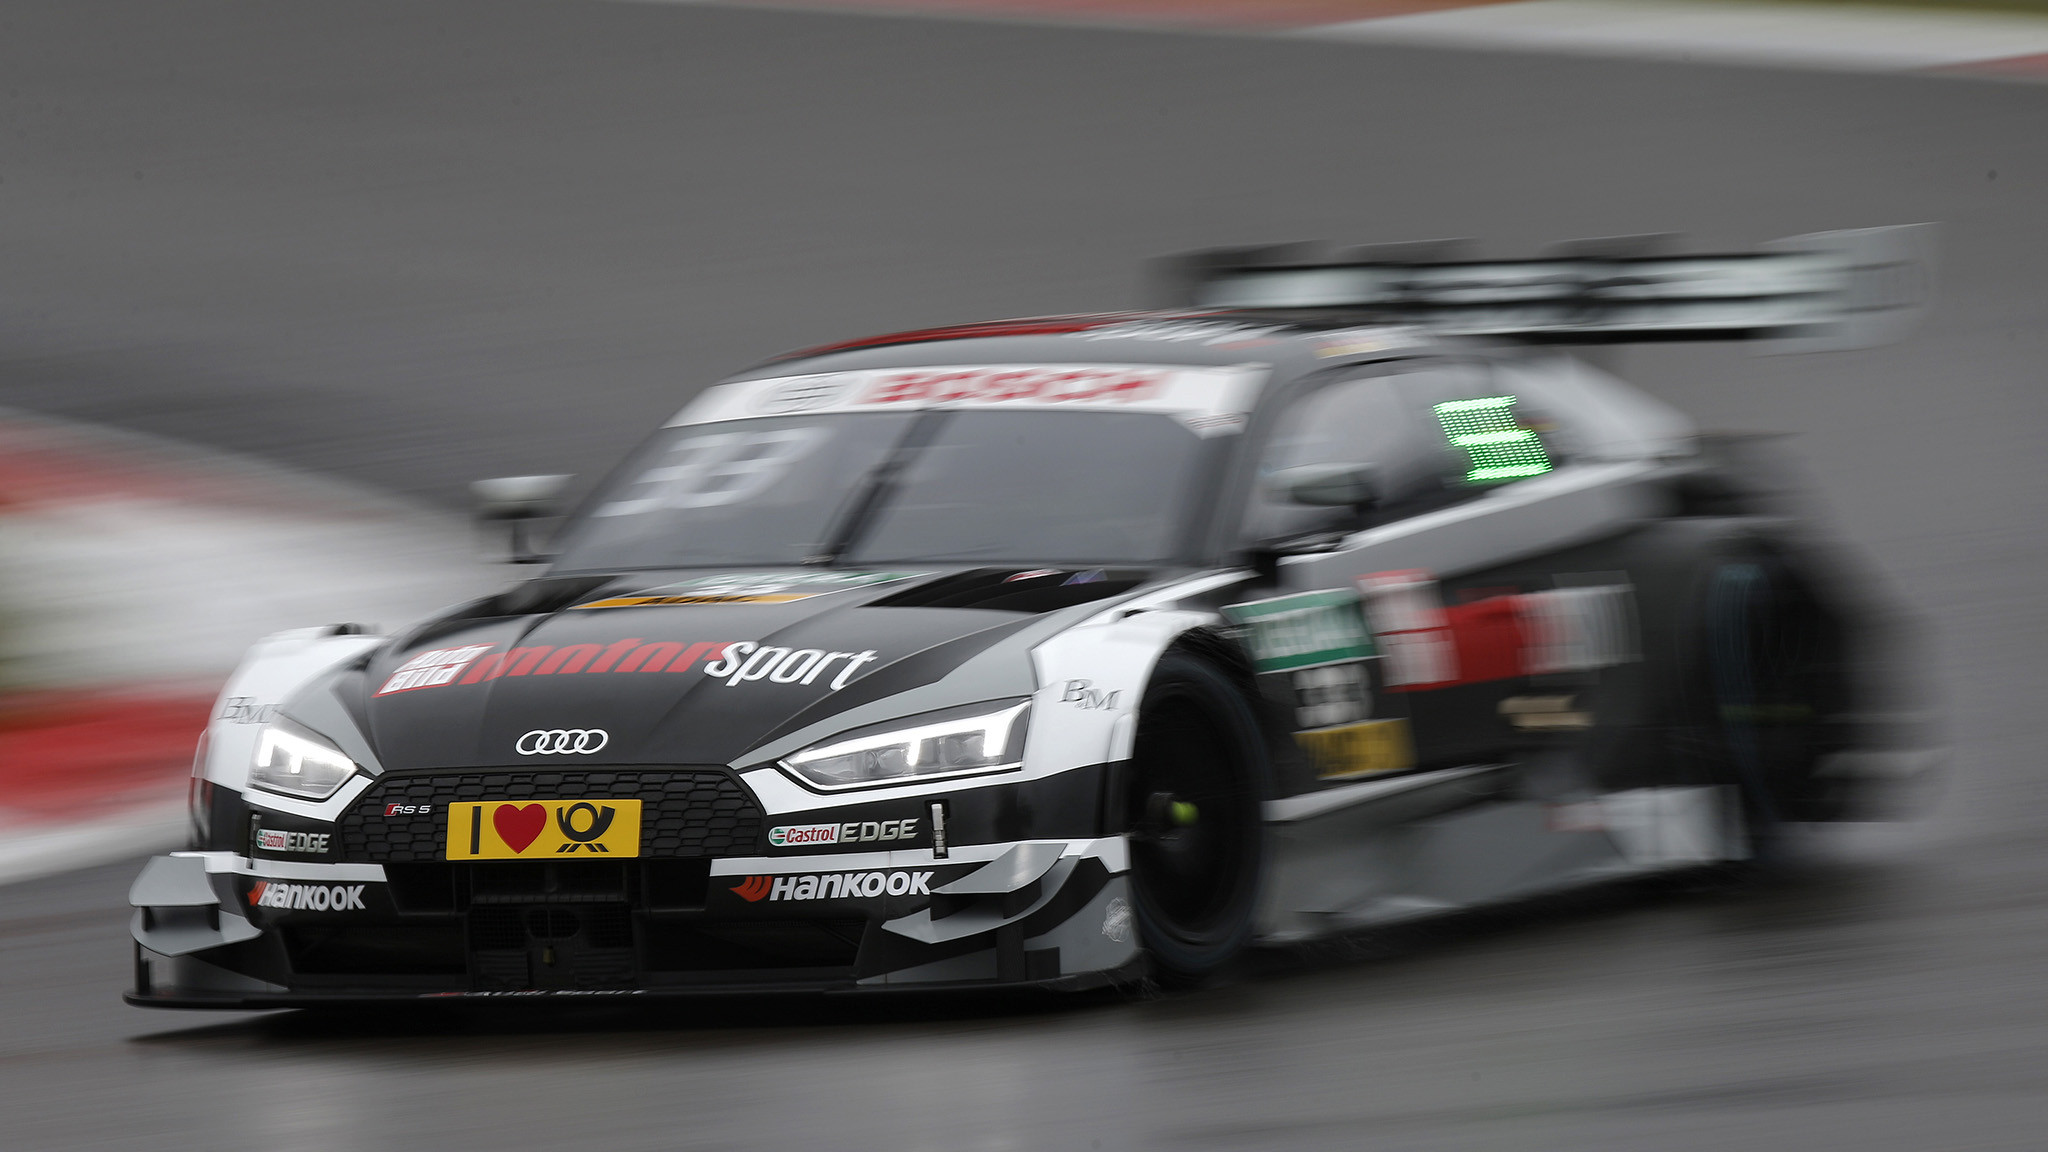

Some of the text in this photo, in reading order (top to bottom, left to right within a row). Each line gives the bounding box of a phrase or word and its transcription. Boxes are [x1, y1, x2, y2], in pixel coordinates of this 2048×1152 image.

[391, 804, 416, 815] RS
[786, 817, 920, 844] Castrol EDGE
[288, 831, 331, 853] EDGE
